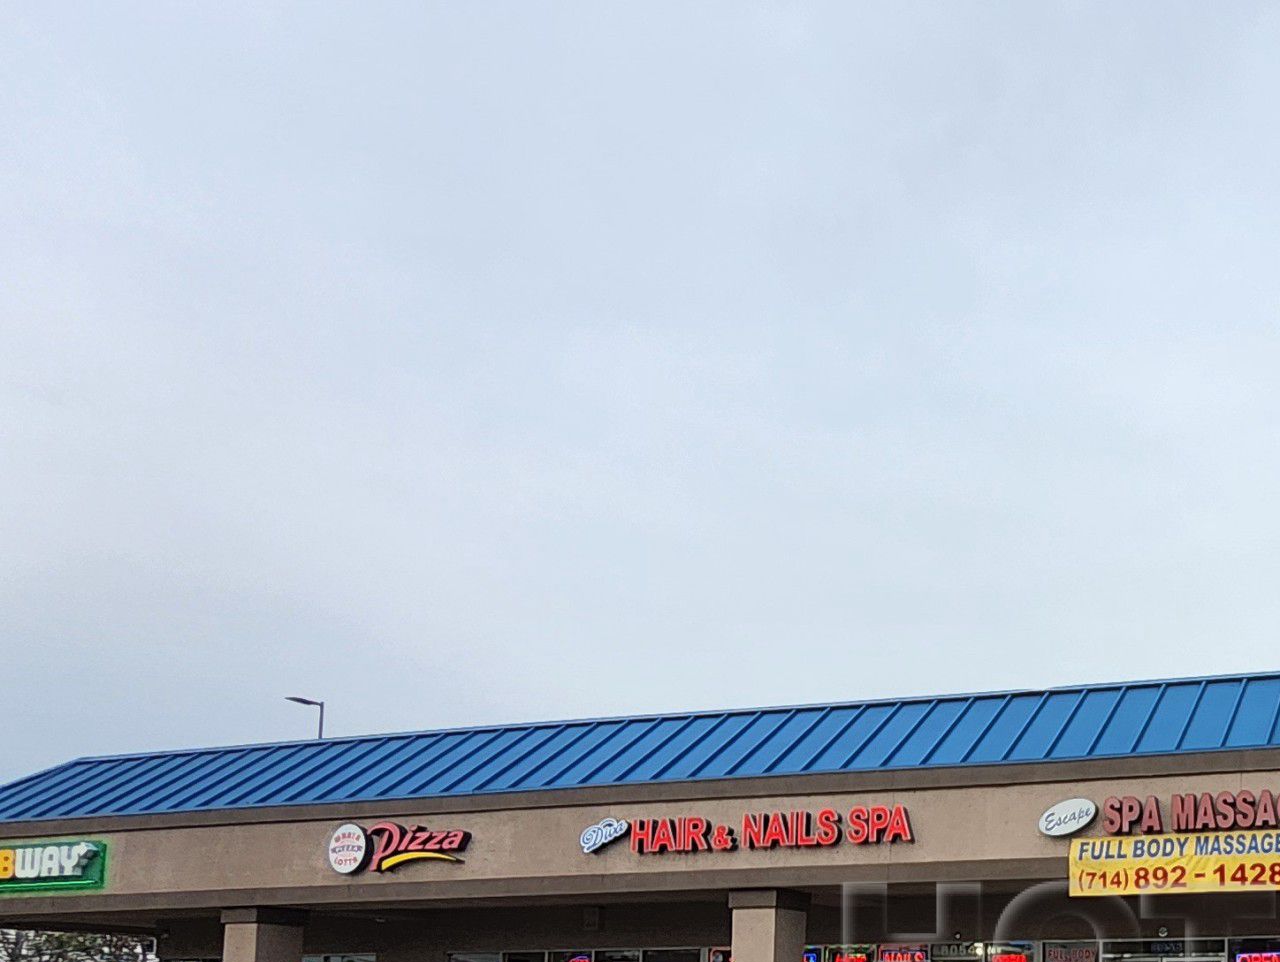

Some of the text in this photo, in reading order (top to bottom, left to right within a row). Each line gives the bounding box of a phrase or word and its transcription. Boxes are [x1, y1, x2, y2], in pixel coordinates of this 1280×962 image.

[630, 803, 912, 854] HAIR & NAILS SPA
[1043, 805, 1093, 831] Escape
[1103, 795, 1163, 834] SPA
[366, 820, 465, 872] Pizza
[580, 817, 629, 853] Diva
[1078, 839, 1128, 861] FULL
[1132, 837, 1189, 859] BODY
[1078, 867, 1129, 891] (714)
